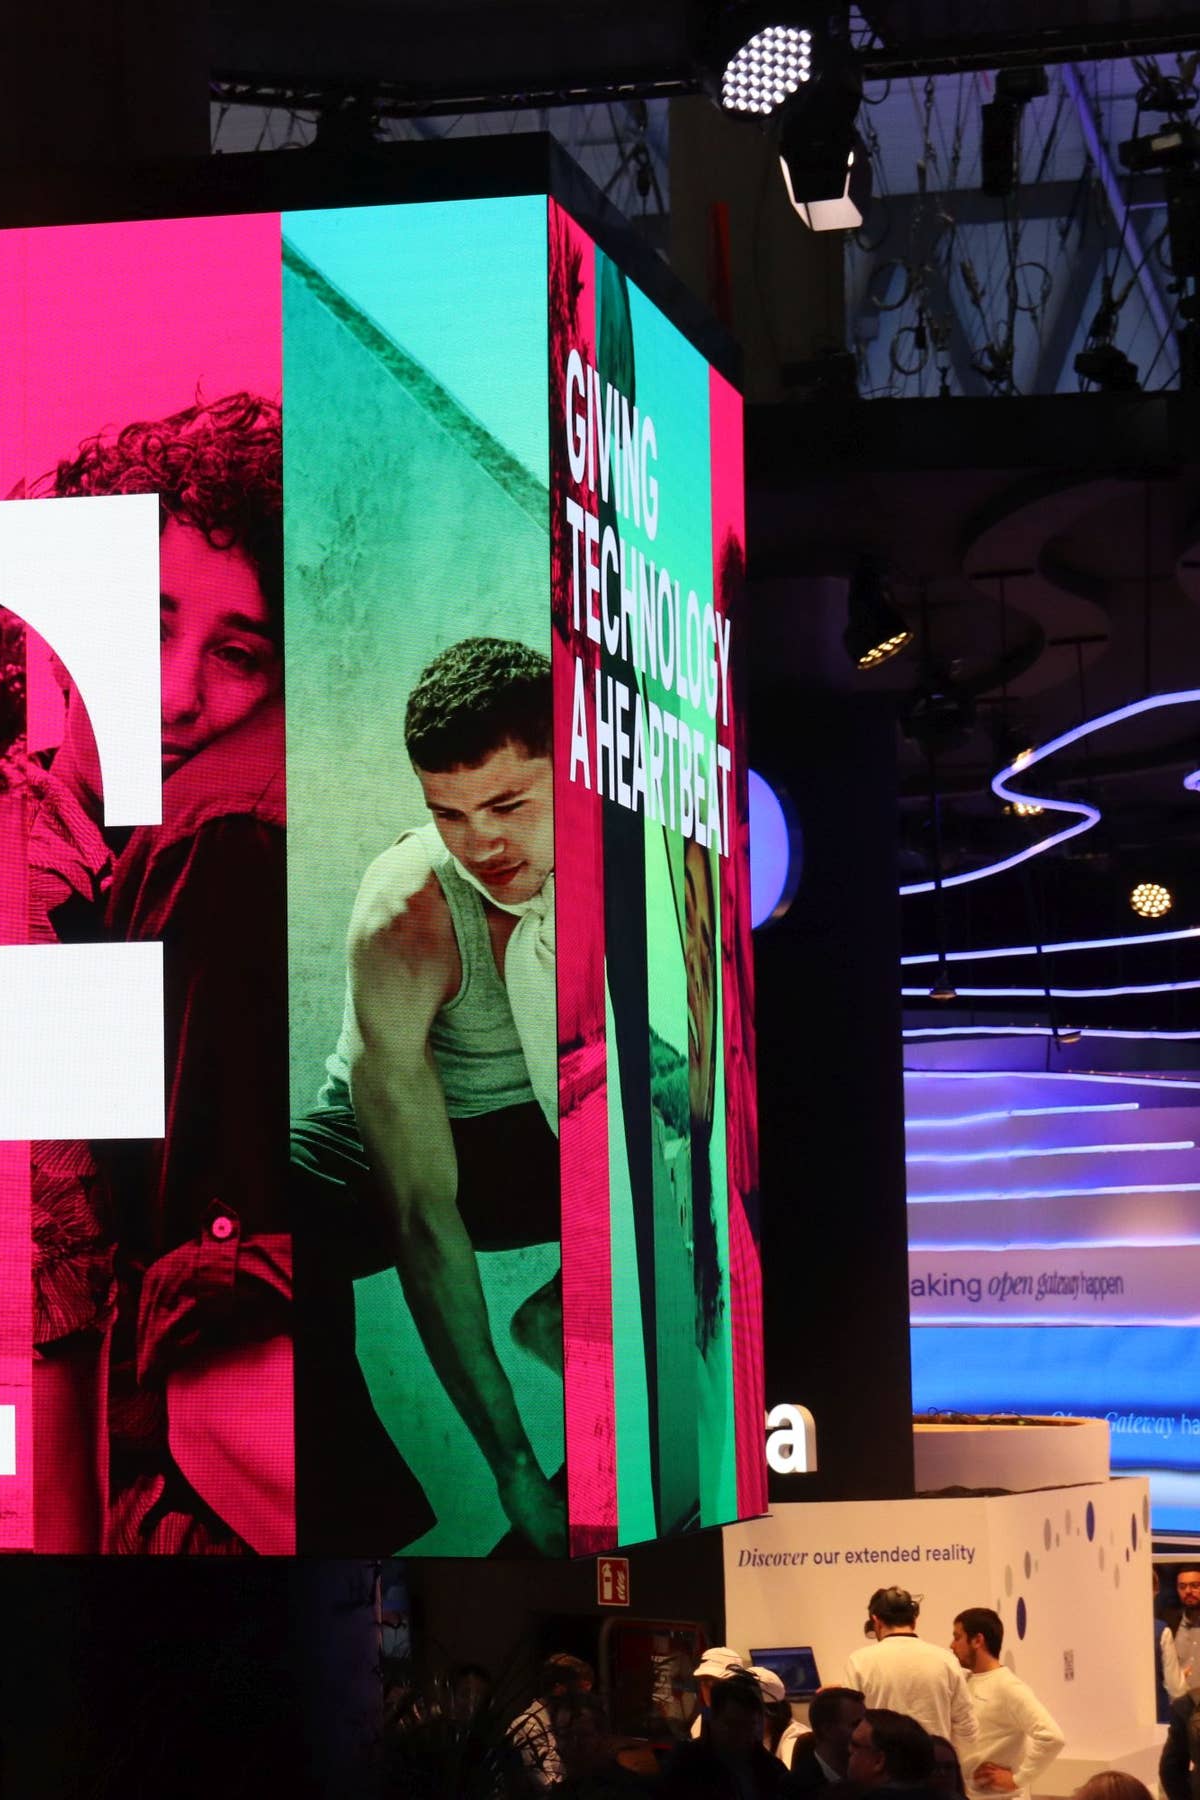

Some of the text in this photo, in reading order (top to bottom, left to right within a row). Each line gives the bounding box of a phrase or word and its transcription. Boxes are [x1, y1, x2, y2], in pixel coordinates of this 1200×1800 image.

[566, 348, 658, 541] GIVING
[566, 496, 731, 727] TECHNOLOGY
[569, 656, 731, 858] A HEARTBEAT
[988, 1272, 1033, 1302] open
[1081, 1270, 1124, 1301] happen
[765, 1403, 810, 1474] a
[738, 1544, 976, 1567] Discover our extended reality
